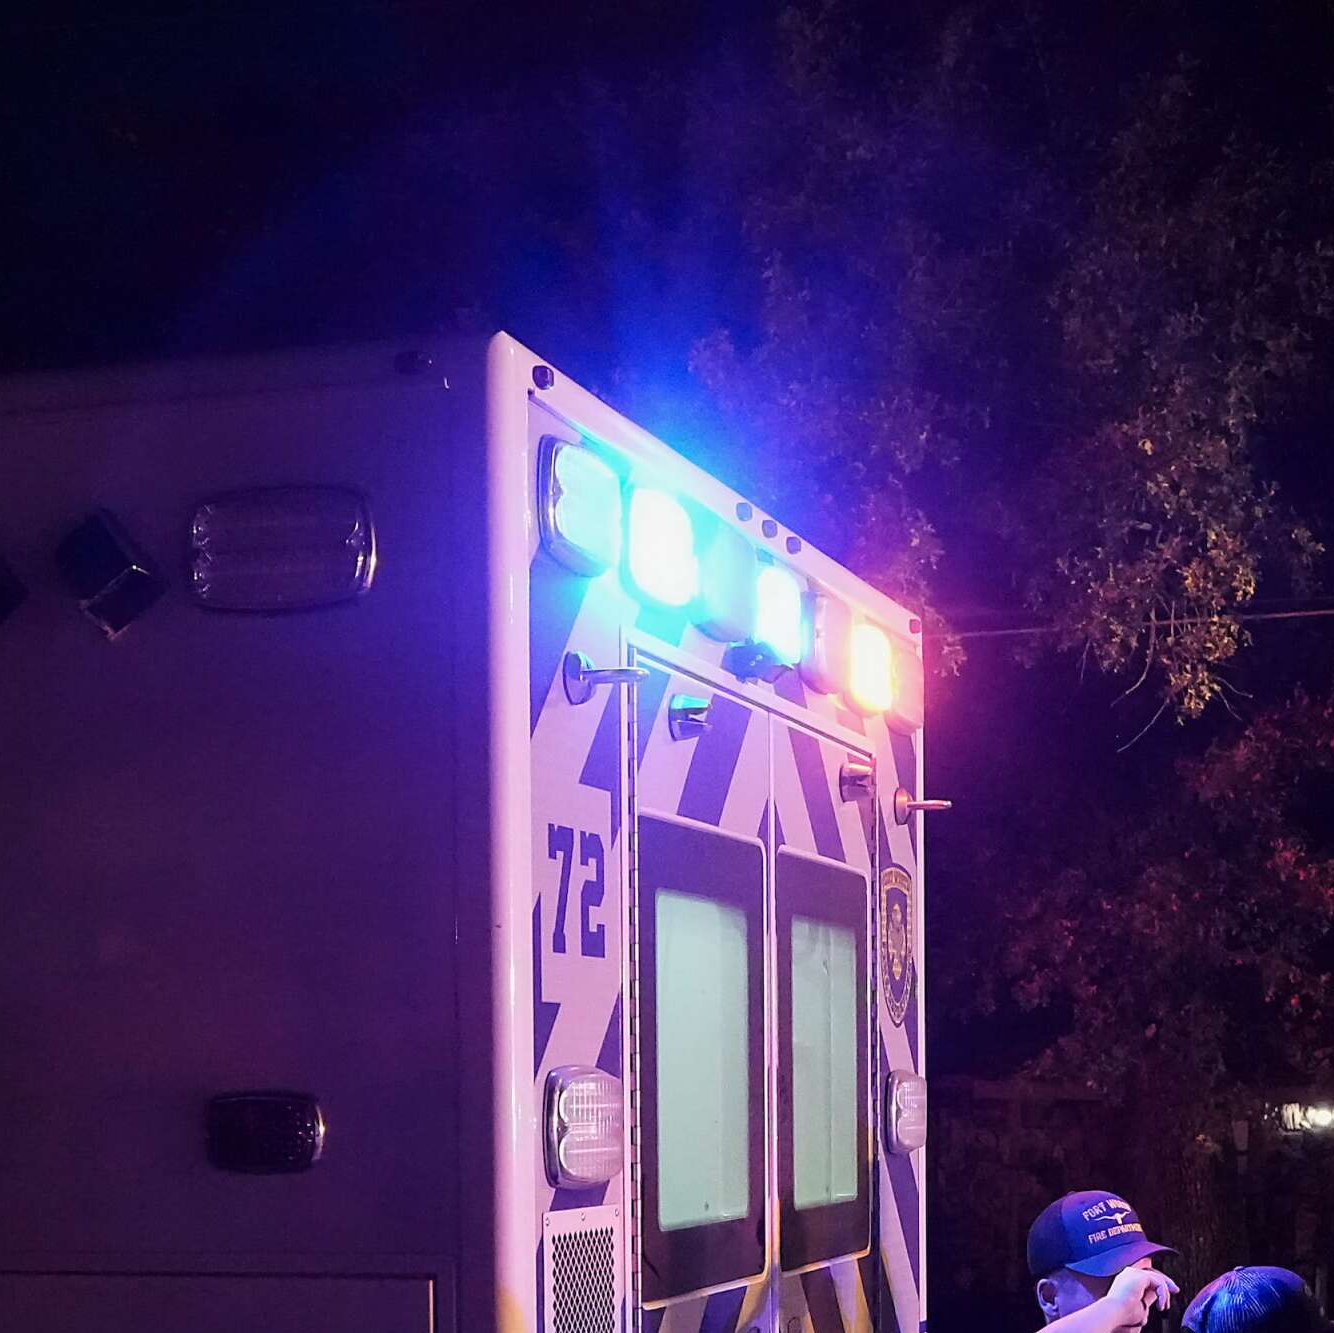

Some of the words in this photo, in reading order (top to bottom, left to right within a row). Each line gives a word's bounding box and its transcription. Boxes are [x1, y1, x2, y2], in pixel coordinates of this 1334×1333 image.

[548, 823, 606, 959] 72
[1082, 1201, 1106, 1221] FORT
[1088, 1230, 1107, 1244] FIRE
